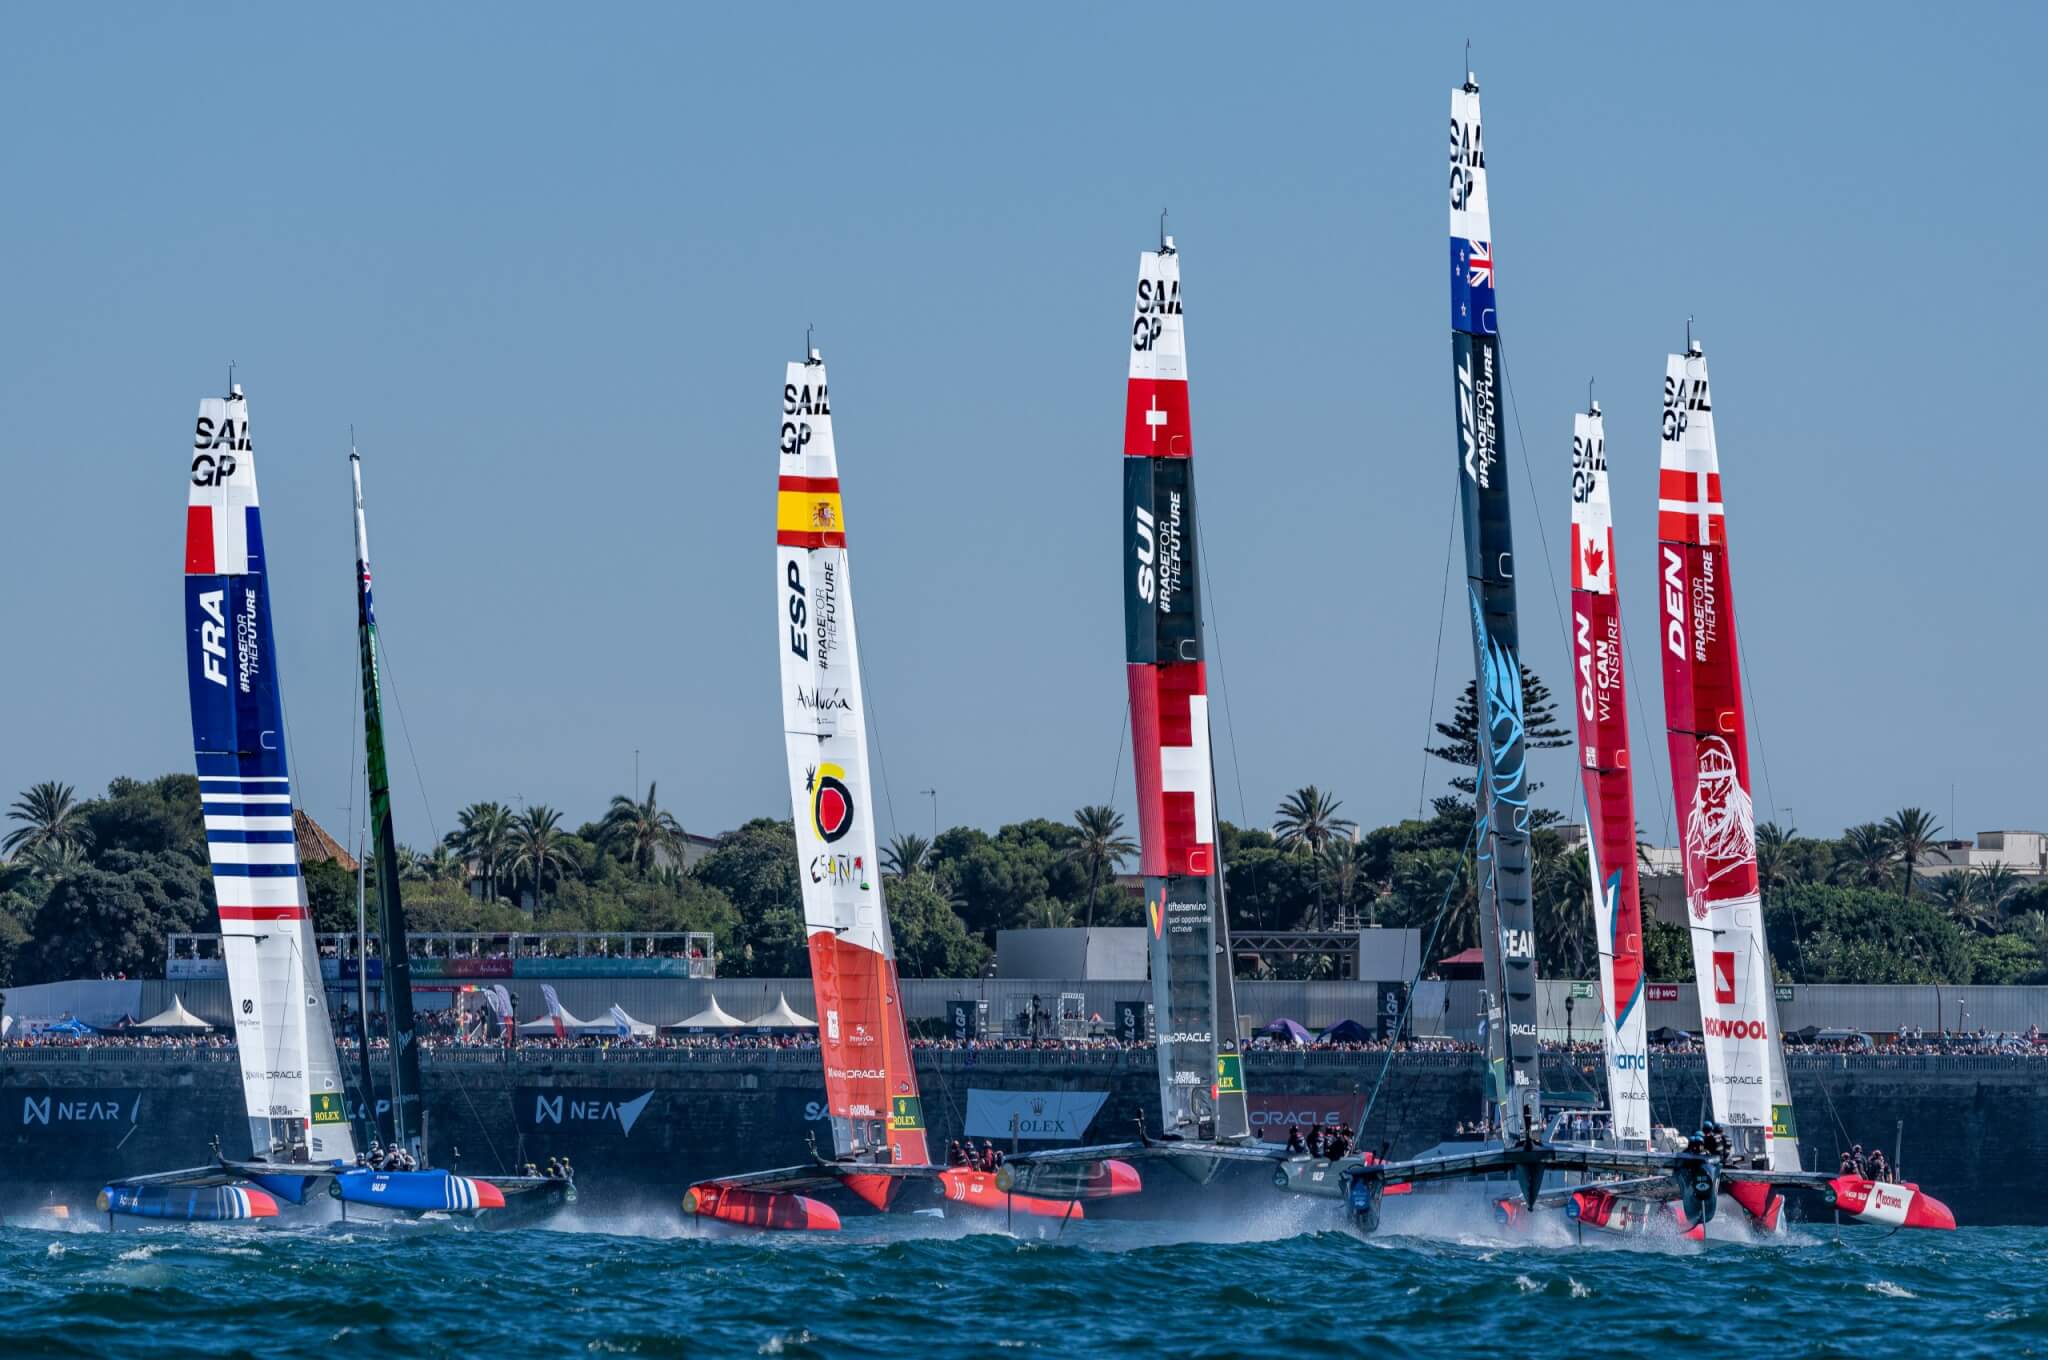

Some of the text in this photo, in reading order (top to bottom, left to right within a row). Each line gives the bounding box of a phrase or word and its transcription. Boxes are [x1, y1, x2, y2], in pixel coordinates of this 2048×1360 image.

[1450, 166, 1473, 211] GP
[1134, 316, 1162, 351] GP
[784, 384, 831, 415] SAIL
[1458, 352, 1477, 483] NZL
[1484, 344, 1496, 464] THEFUTURE
[1662, 410, 1687, 441] GP
[1663, 376, 1711, 411] SAIL
[192, 455, 236, 486] GP
[781, 422, 812, 454] GP
[1476, 380, 1489, 489] #RACEFOR
[1572, 471, 1595, 503] GP
[1136, 505, 1154, 604] SUI
[1160, 520, 1171, 613] #RACEFOR
[1170, 490, 1180, 592] THEFUTURE
[246, 588, 259, 675] THEFUTURE
[787, 559, 808, 661] ESP
[815, 588, 829, 669] #RACEFOR
[825, 561, 837, 650] THEFUTURE
[1663, 546, 1686, 661] DEN
[1692, 577, 1707, 662] #RACEFOR
[1702, 549, 1717, 642] THEFUTURE
[199, 589, 228, 688] FRA
[236, 614, 250, 693] #RACEFOR
[1576, 611, 1594, 721] CAN
[1607, 616, 1620, 689] INSPIRE
[1596, 640, 1610, 721] WE CAN
[1173, 1033, 1212, 1043] ORACLE
[1511, 1024, 1537, 1035] RACLE
[571, 1101, 617, 1120] NEA
[847, 1069, 885, 1079] ORACLE
[1218, 1077, 1234, 1088] LEX
[58, 1102, 120, 1120] NEAR
[314, 1112, 340, 1121] ROLEX
[1249, 1111, 1341, 1126] ORACLE
[1773, 1124, 1788, 1135] LEX
